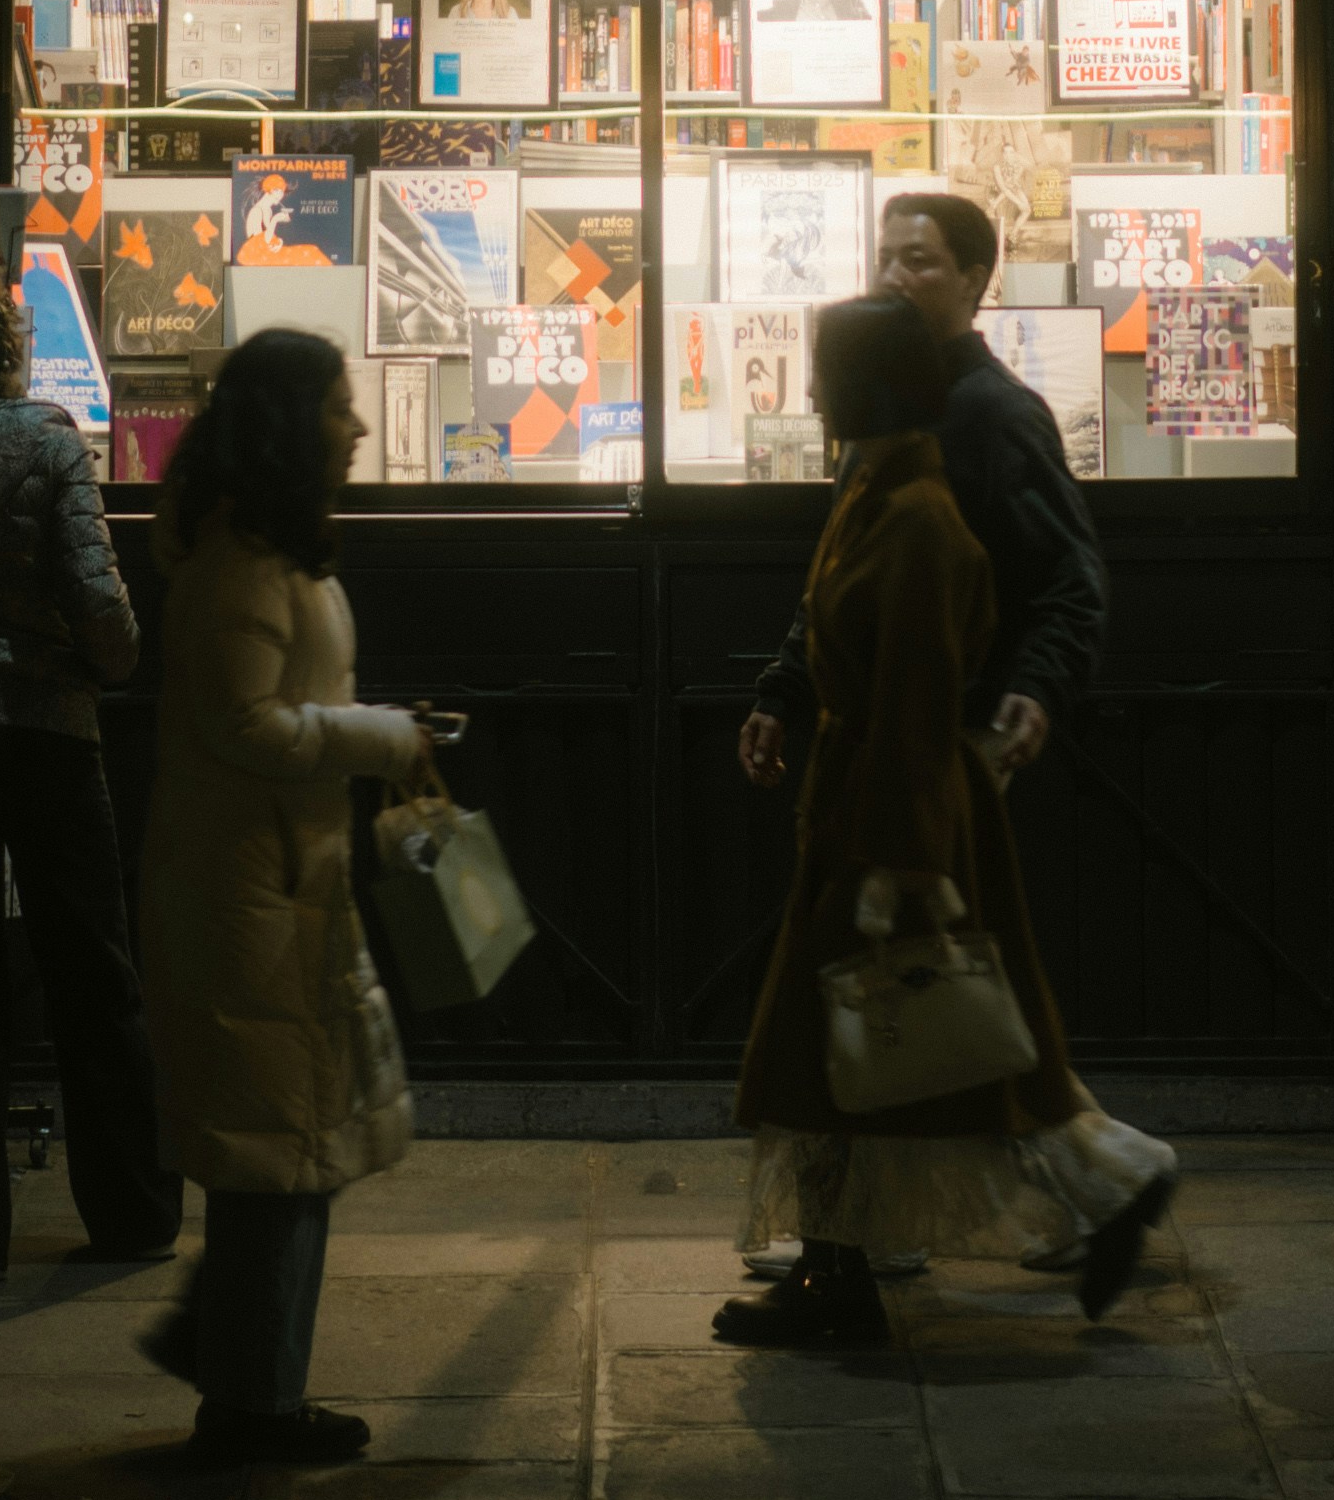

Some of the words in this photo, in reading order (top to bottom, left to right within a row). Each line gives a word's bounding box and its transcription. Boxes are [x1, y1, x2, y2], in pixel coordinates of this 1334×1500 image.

[1065, 36, 1123, 51] VOTRE
[1130, 36, 1182, 50] LIVRE
[1066, 53, 1108, 64] JUSTE
[1112, 53, 1131, 64] EN
[1134, 53, 1160, 63] BAS
[1066, 66, 1121, 82] CHEZ
[1124, 65, 1183, 82] VOUS
[53, 118, 98, 133] 2025
[238, 159, 347, 172] MONTPARNASSE
[14, 163, 94, 193] ECO
[312, 172, 325, 180] DU
[398, 178, 489, 202] NORD
[407, 200, 478, 213] EXPRESS
[579, 217, 601, 228] ART
[602, 214, 635, 228] DÉCO
[1088, 212, 1130, 228] 1925
[1150, 212, 1196, 228] 2025
[588, 228, 614, 238] GRAND
[616, 228, 634, 238] LIVRE
[1112, 229, 1144, 239] CENT
[1148, 229, 1173, 239] ANS
[1104, 238, 1181, 260] D'ART
[481, 309, 524, 325] 1925
[544, 309, 591, 325] 2025
[1158, 303, 1230, 325] L'ART
[127, 316, 152, 332] ART
[155, 314, 195, 332] DÉCO
[505, 326, 537, 336] CENT
[542, 326, 567, 336] ANS
[497, 335, 577, 357] D'ART
[31, 358, 90, 371] OSITION
[1158, 353, 1195, 376] DES
[1158, 376, 1247, 402] RÉGIONS
[587, 411, 617, 427] ART
[619, 406, 643, 426] DÉ
[753, 419, 781, 432] PARIS
[782, 416, 819, 432] DÉCORS
